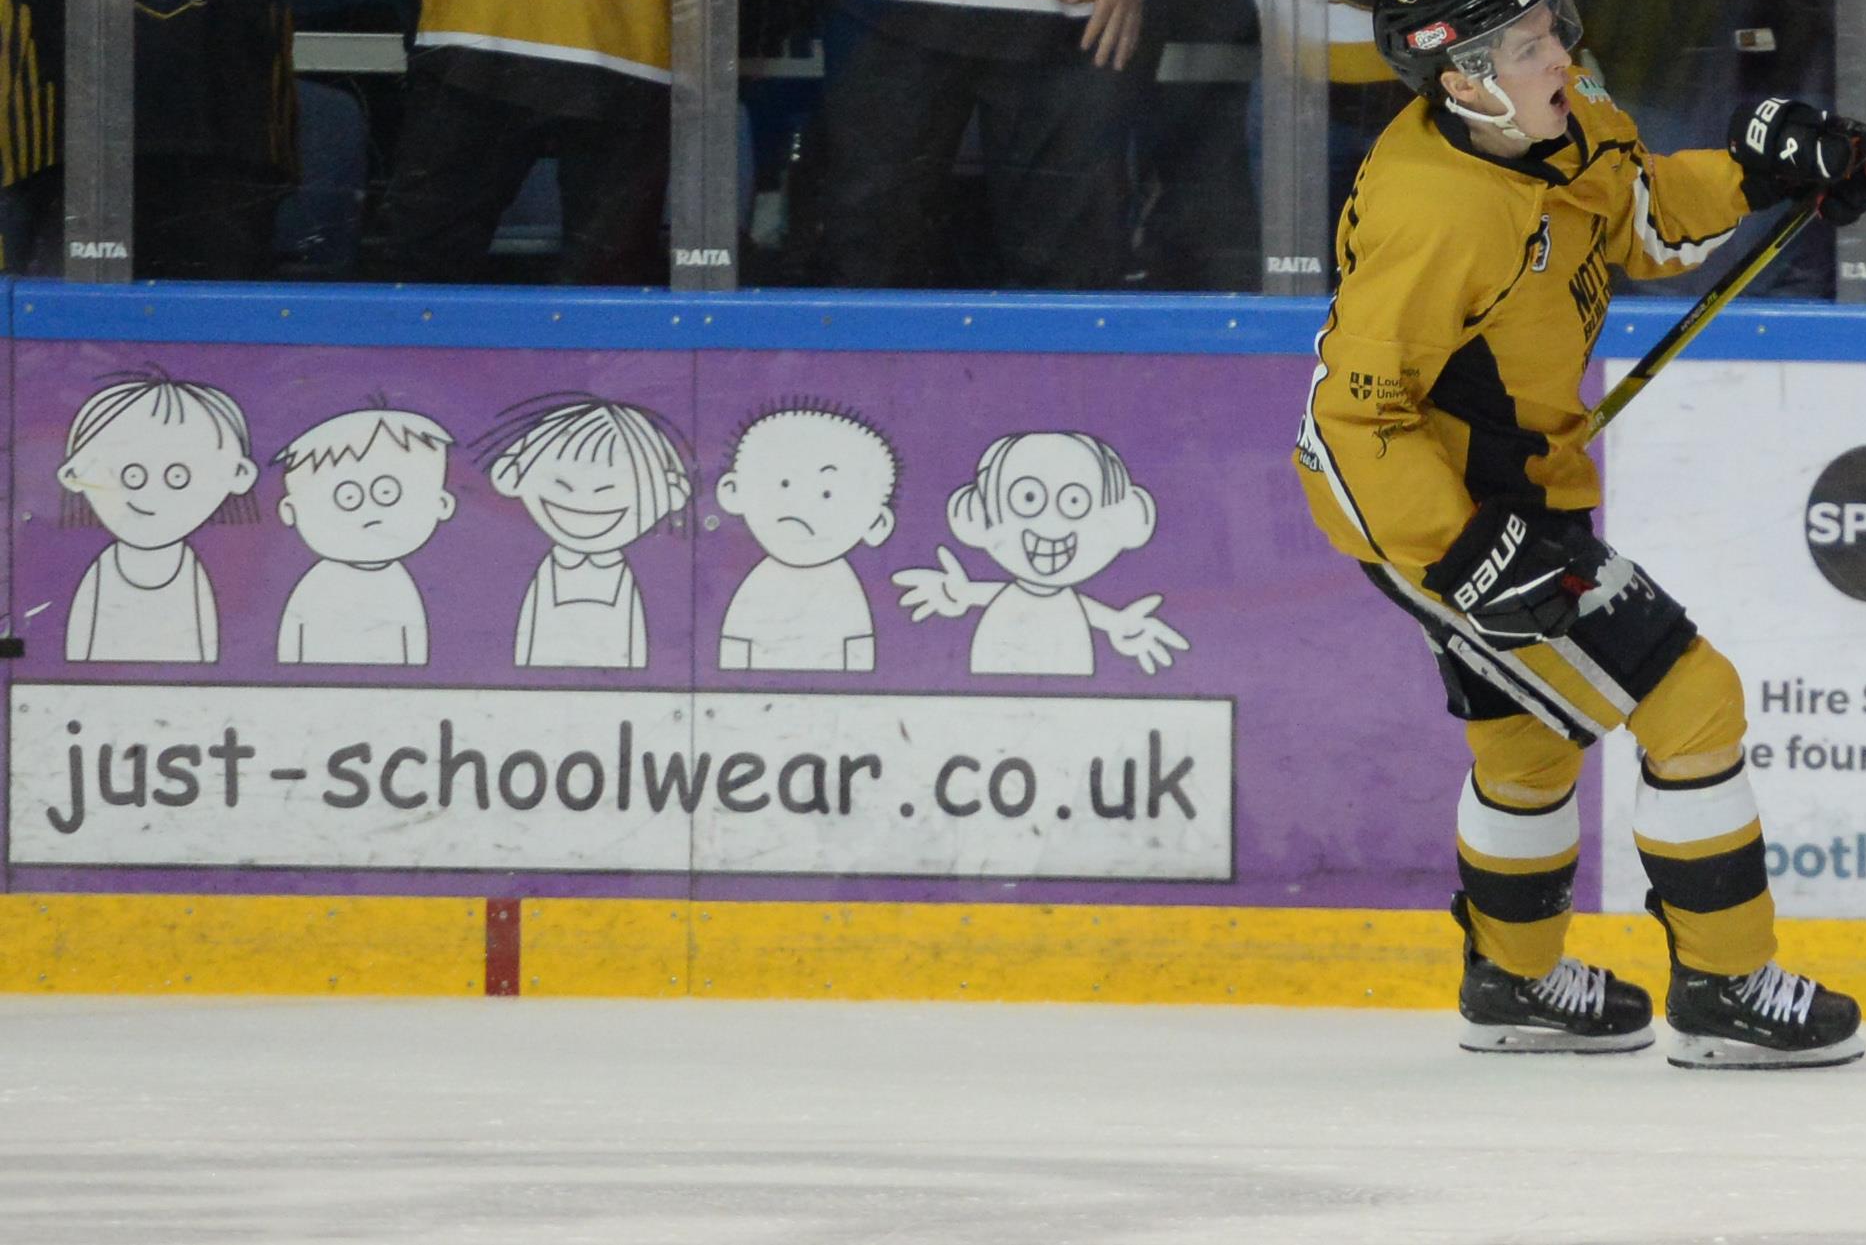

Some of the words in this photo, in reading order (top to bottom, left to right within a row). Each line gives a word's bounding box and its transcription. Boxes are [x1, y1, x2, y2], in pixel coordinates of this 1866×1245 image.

[70, 241, 128, 259] RAITA
[675, 249, 731, 266] RAITA
[1267, 256, 1322, 273] RAITA
[1762, 678, 1850, 715] Hire
[46, 720, 1197, 835] just-schoolwear.co.uk
